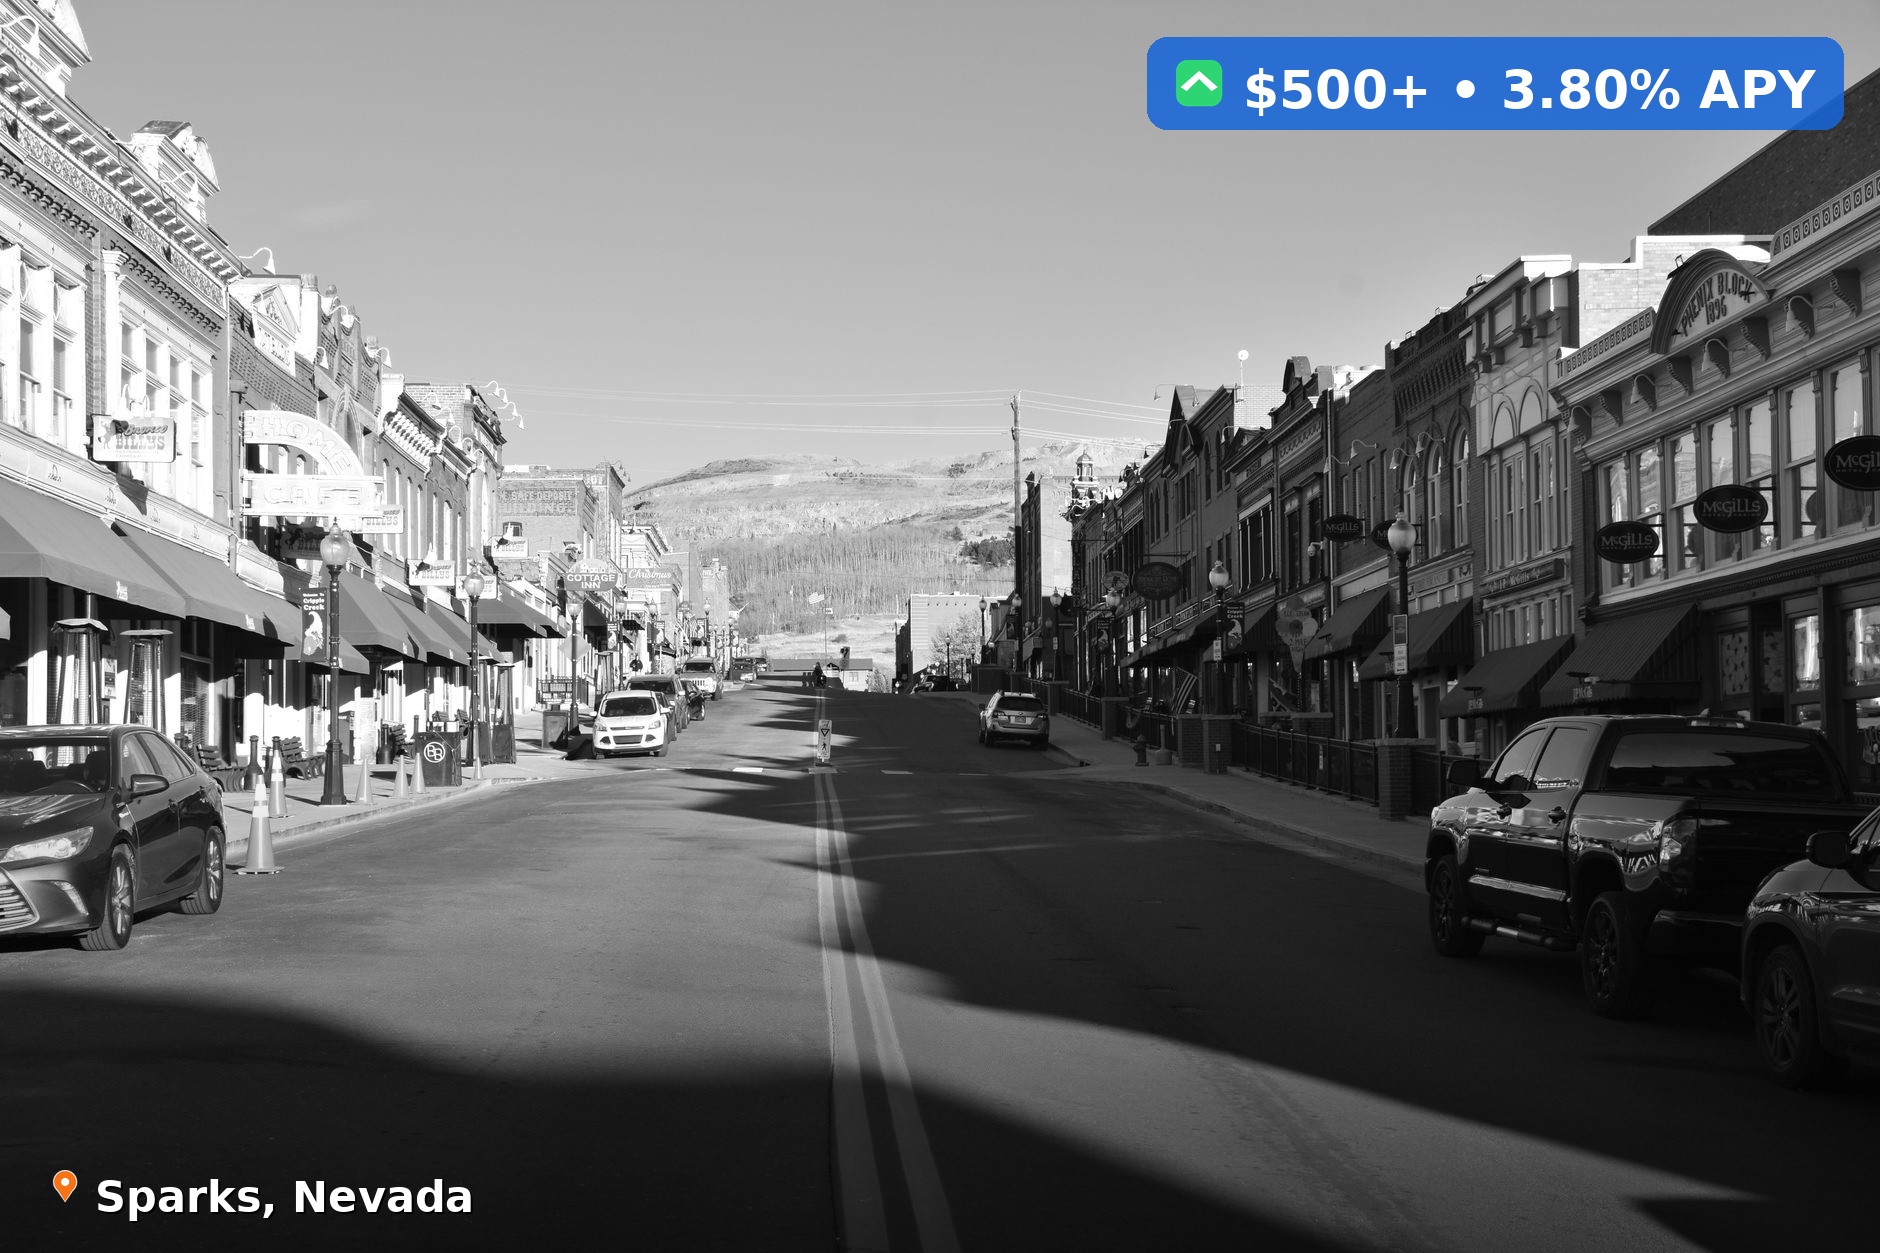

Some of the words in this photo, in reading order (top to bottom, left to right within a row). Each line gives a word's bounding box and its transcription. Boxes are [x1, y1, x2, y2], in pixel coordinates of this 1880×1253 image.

[1681, 276, 1714, 337] PHENIX
[1717, 272, 1752, 303] BLOCK
[1706, 295, 1727, 325] 1896
[262, 415, 353, 474] HOME
[264, 486, 361, 505] CAFE
[567, 574, 616, 582] COTTAGE
[581, 581, 601, 589] INN
